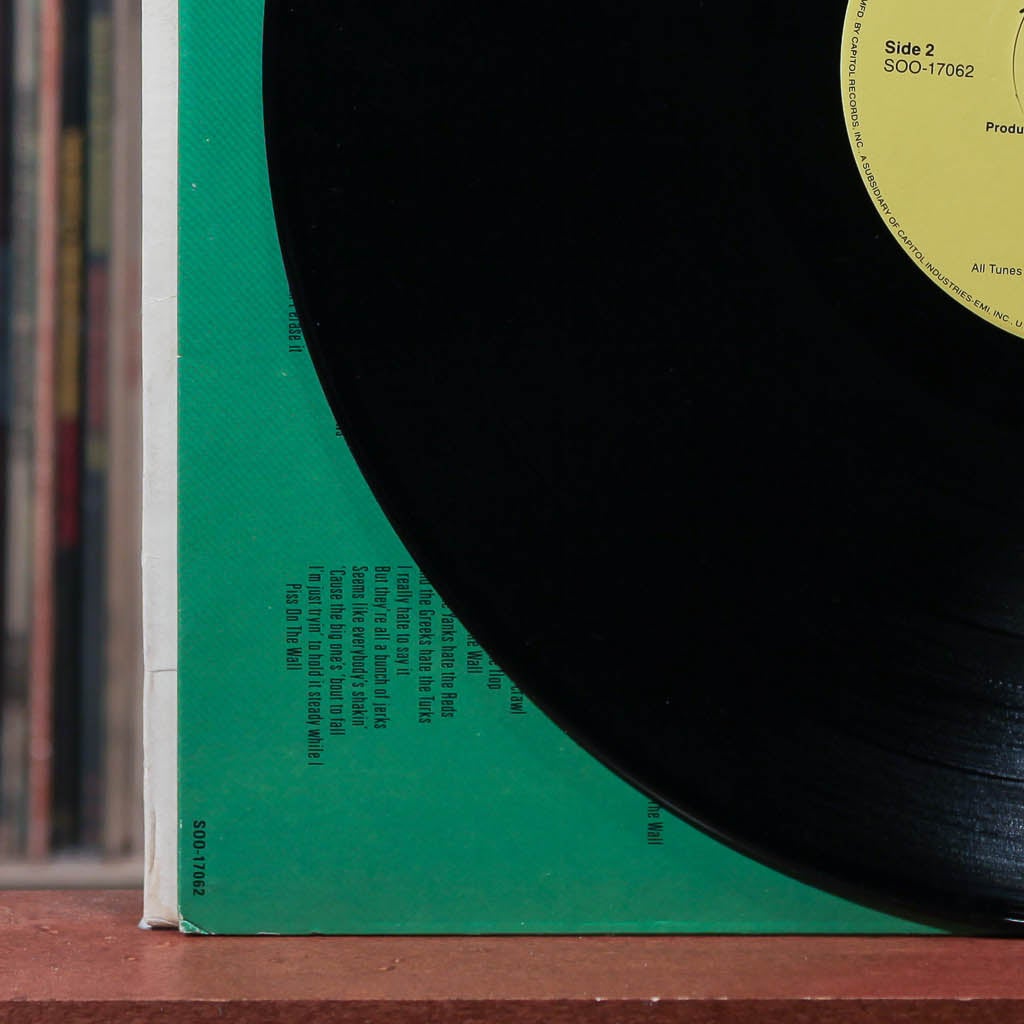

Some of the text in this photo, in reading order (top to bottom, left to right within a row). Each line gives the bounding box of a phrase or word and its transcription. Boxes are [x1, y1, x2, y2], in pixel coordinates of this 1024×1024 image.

[854, 23, 861, 35] BY
[849, 36, 858, 77] CAPITOL
[885, 41, 934, 56] Side 2
[884, 59, 974, 77] SOO-17062
[862, 163, 892, 215] SUBSIDIARY
[889, 217, 900, 228] OF
[898, 230, 926, 263] CAPITOL
[971, 263, 985, 273] All
[989, 264, 1022, 276] Tunes
[286, 584, 301, 671] Piss On The Wall
[351, 566, 368, 729] Seems like everybody's shakin'
[192, 820, 206, 896] SOO-17062
